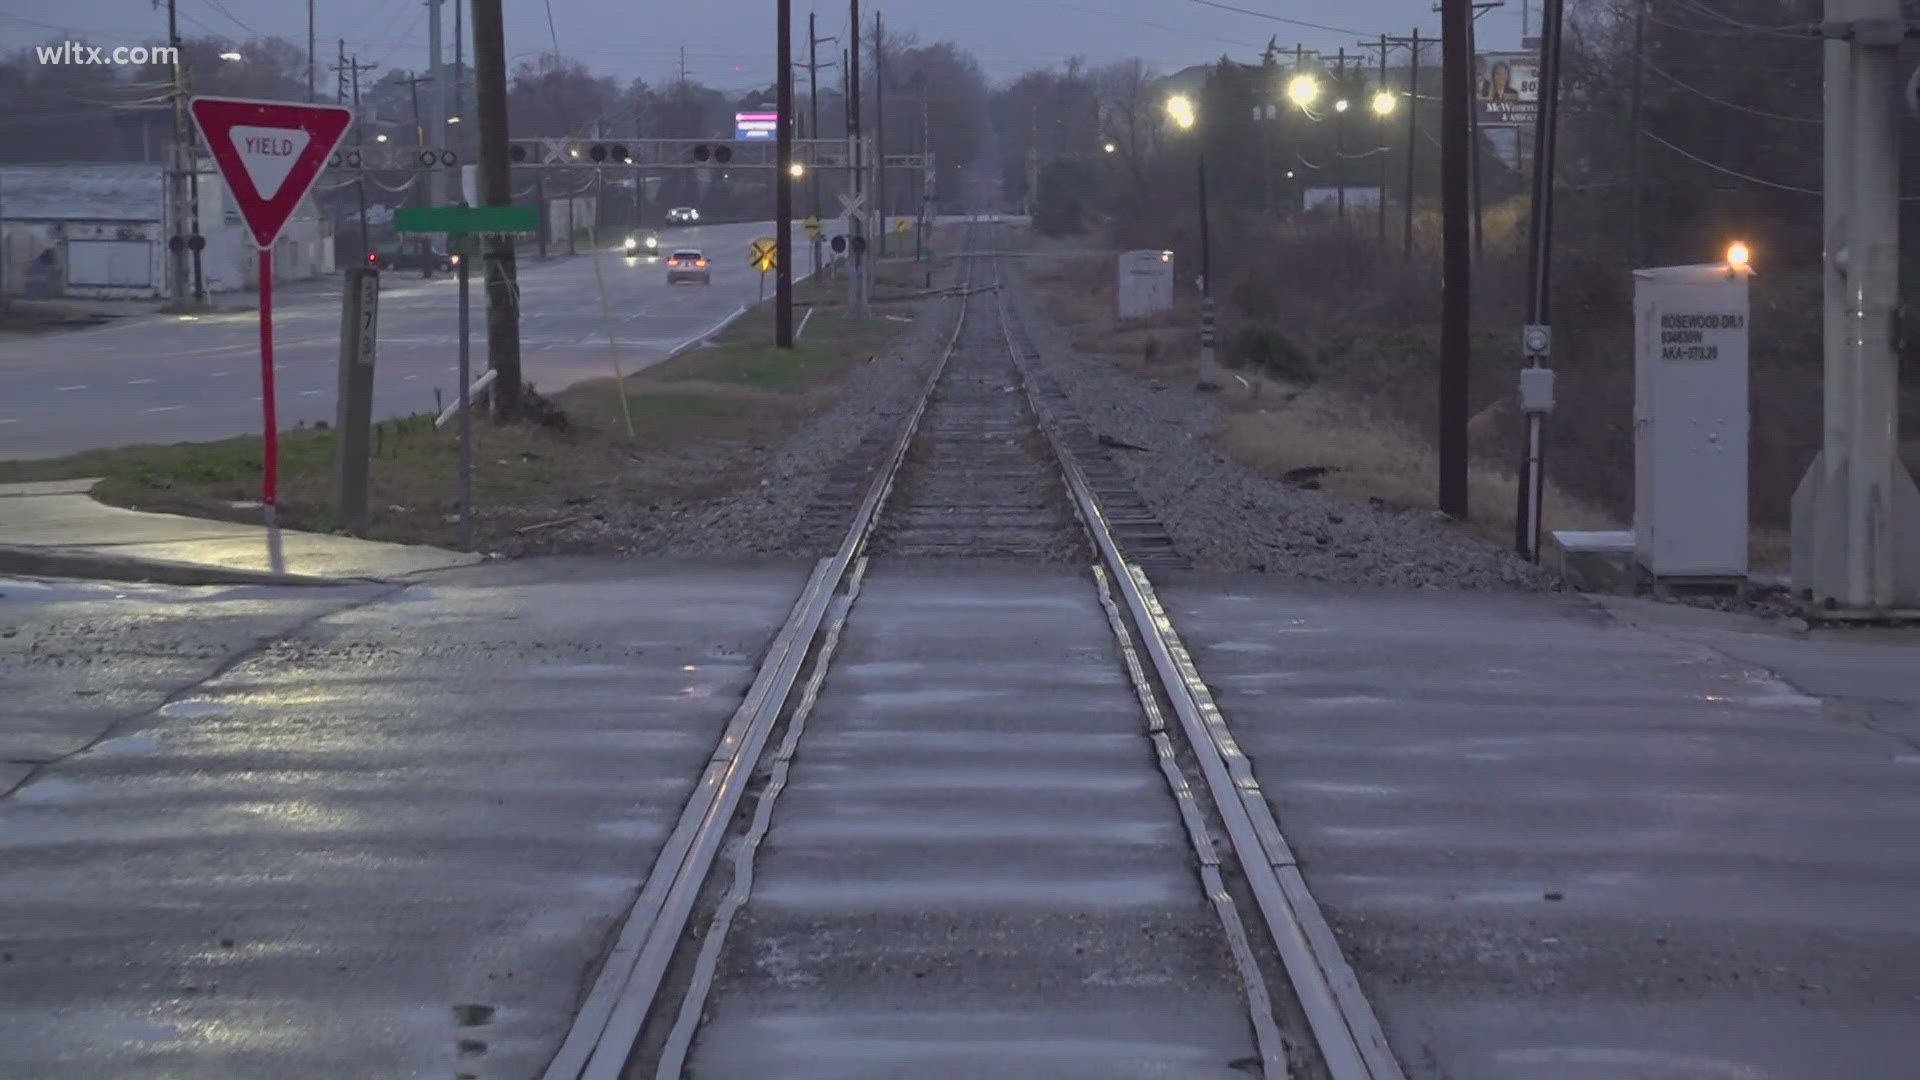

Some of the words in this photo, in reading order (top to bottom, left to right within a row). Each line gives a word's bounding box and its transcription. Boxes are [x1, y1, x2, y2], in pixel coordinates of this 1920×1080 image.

[245, 136, 293, 156] YIELD
[362, 281, 374, 354] 373
[1661, 314, 1720, 329] ROSEWOOD
